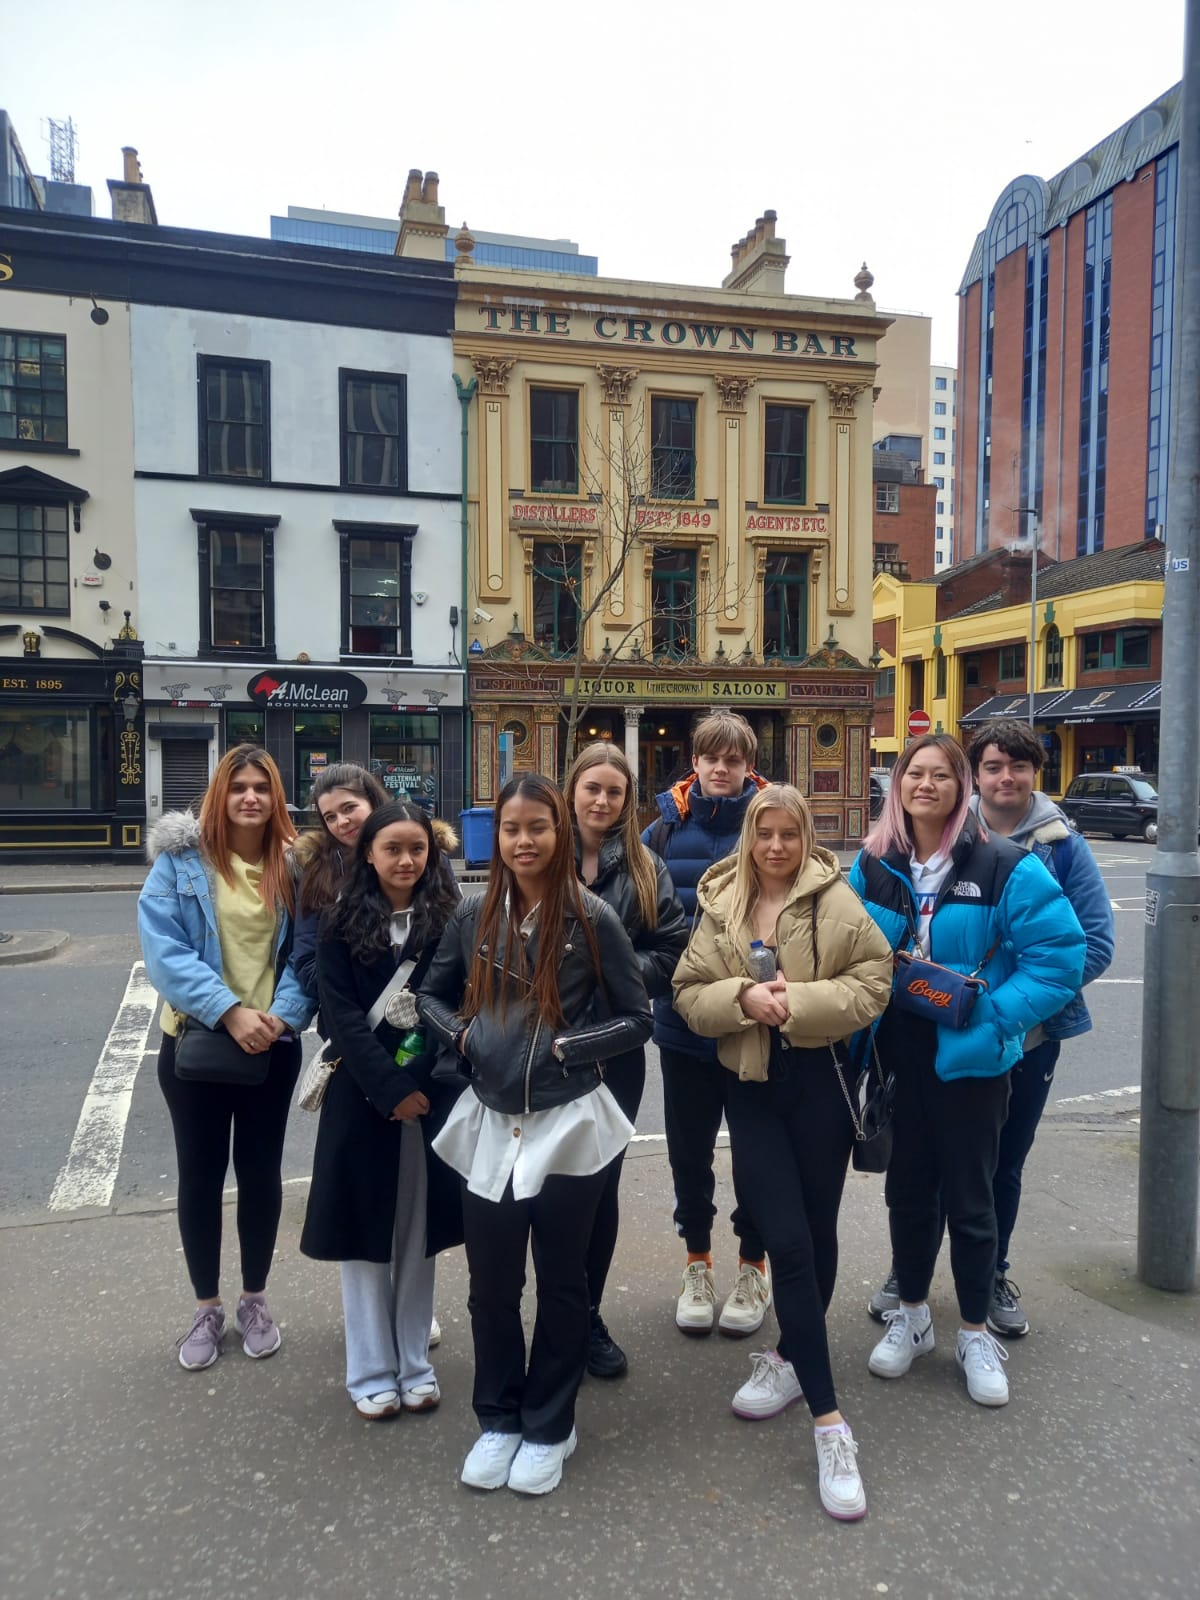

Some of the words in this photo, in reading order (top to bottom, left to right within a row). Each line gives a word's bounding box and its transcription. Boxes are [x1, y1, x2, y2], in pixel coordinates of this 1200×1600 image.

[478, 307, 570, 336] THE
[594, 316, 757, 351] CROWN
[772, 329, 858, 358] BAR
[512, 504, 597, 523] DISTILLERS
[677, 512, 711, 528] 1849
[746, 515, 800, 531] AGENTS
[2, 678, 28, 688] EST.
[36, 679, 63, 690] 1895
[268, 681, 349, 701] A.McLean
[575, 680, 636, 695] IQUOR
[266, 701, 349, 709] BOOKMAKERS
[385, 781, 419, 789] FESTIVAL
